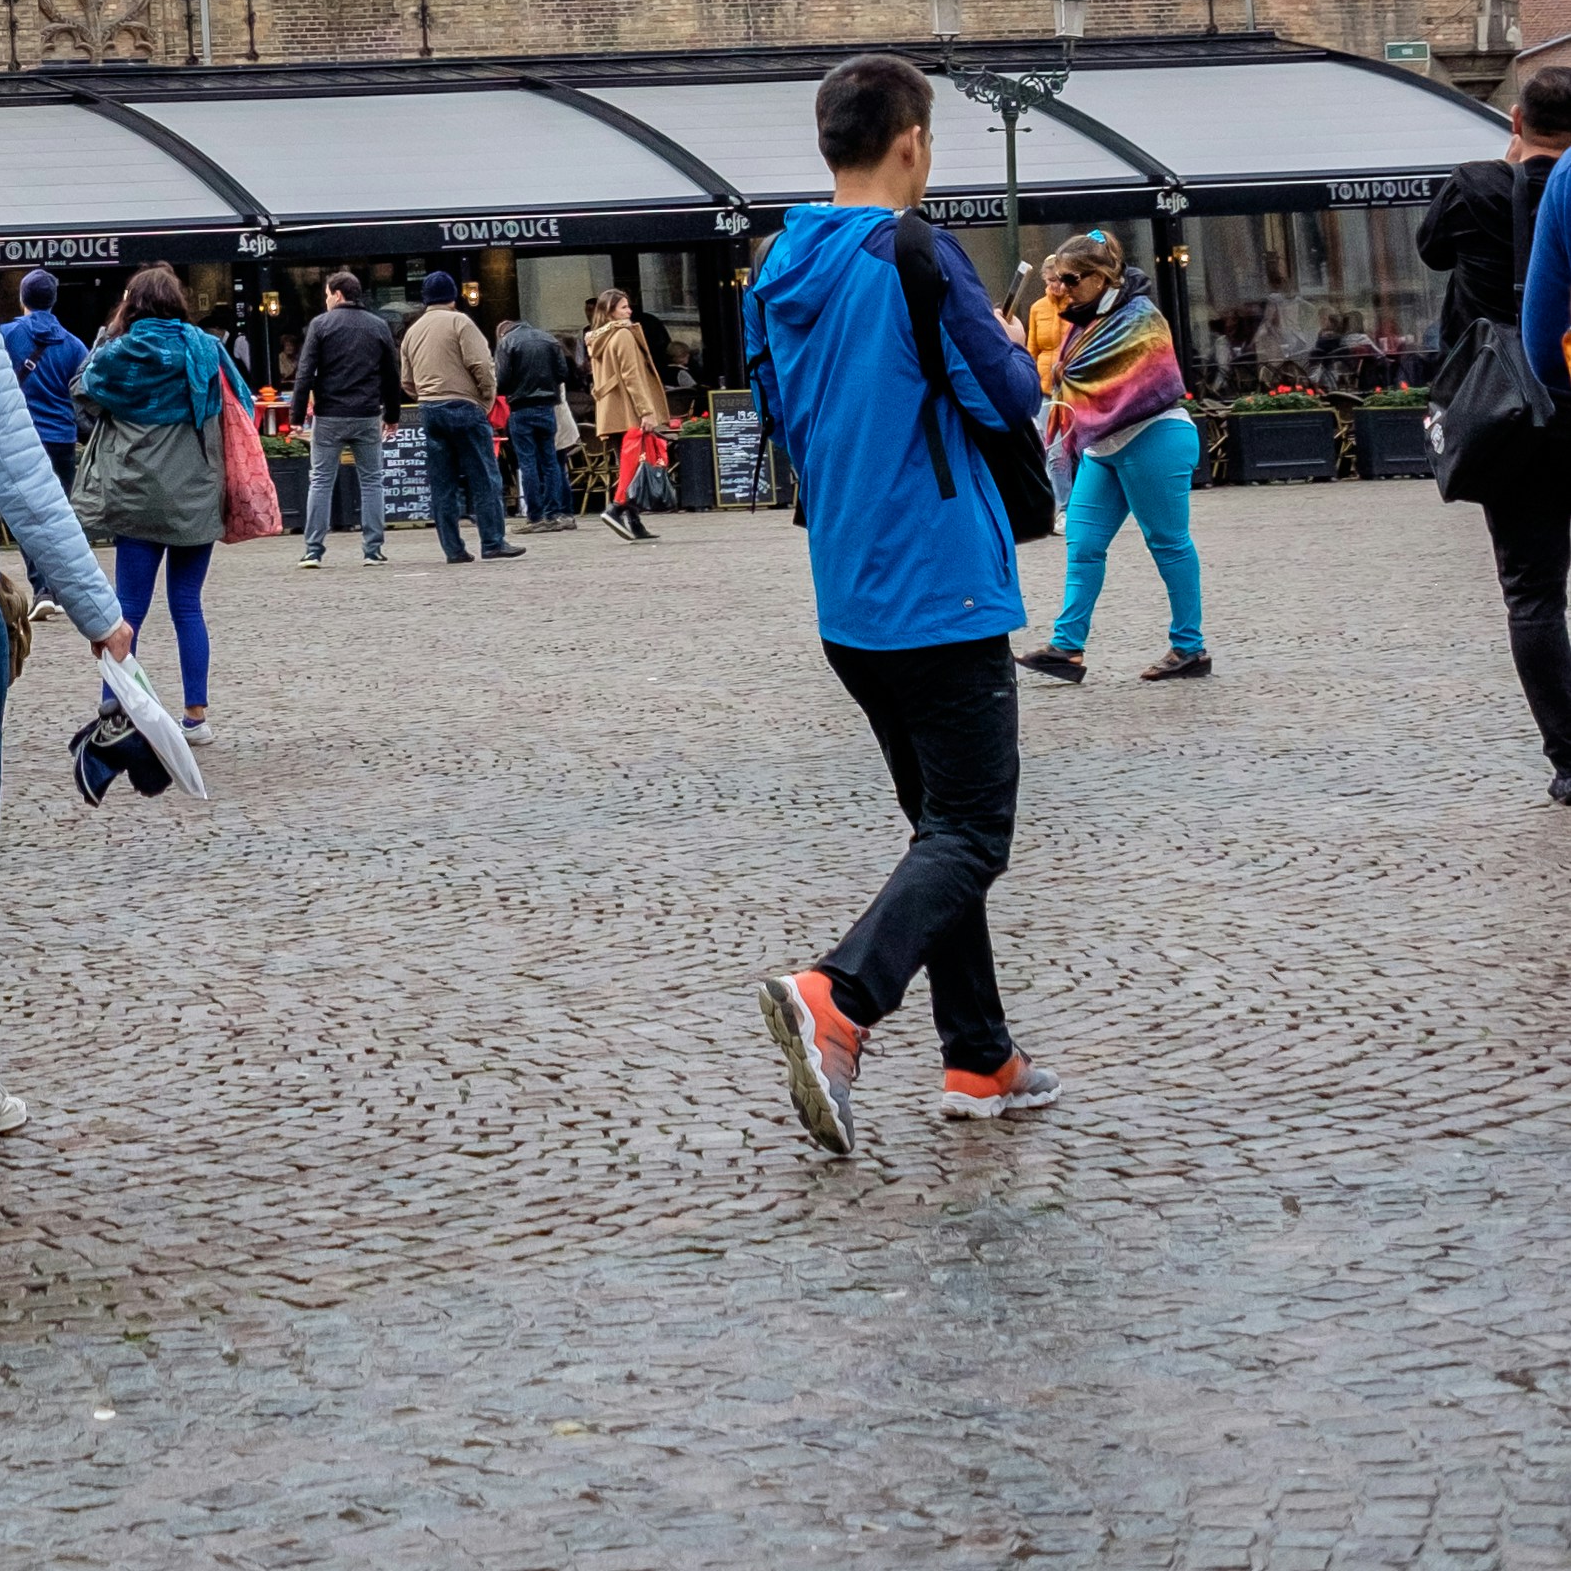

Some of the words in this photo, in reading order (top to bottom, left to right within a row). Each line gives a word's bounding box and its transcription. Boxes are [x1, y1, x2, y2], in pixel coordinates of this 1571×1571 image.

[1156, 191, 1189, 215] Leffe
[714, 211, 750, 235] Leffe
[237, 233, 277, 257] Leffe
[382, 427, 427, 443] SSELS
